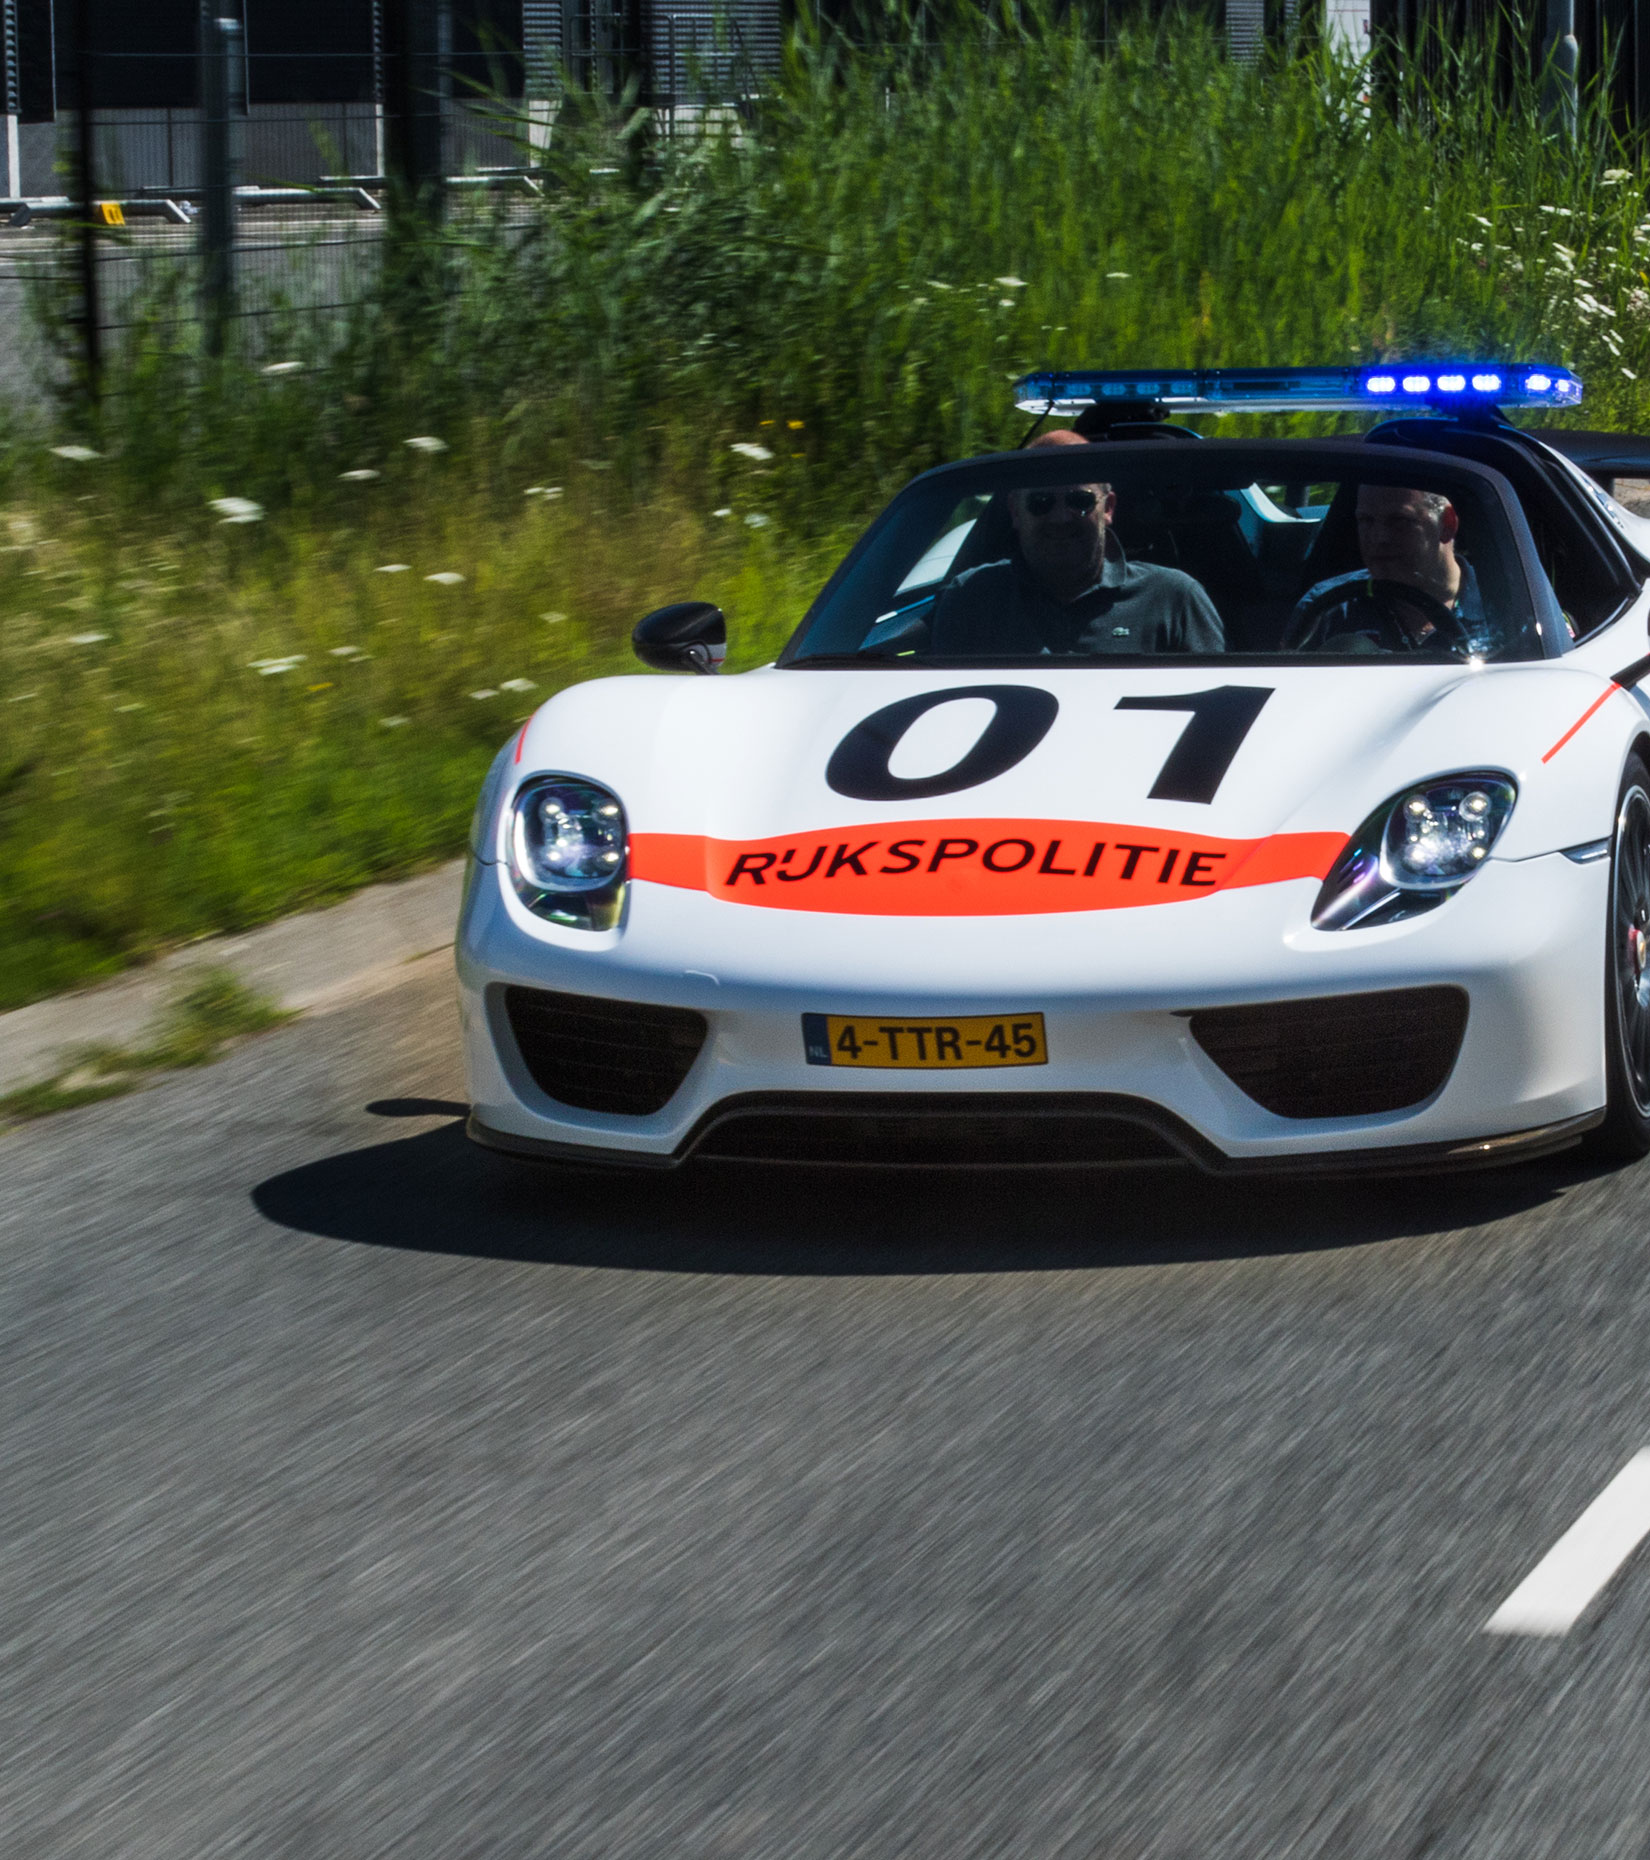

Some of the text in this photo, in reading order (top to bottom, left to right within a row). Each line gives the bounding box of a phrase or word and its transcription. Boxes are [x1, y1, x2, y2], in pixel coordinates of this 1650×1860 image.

[824, 684, 1275, 805] 01
[725, 837, 1228, 887] RIJKSPOLITIE
[808, 1023, 1037, 1061] NL 4-TTR-45
